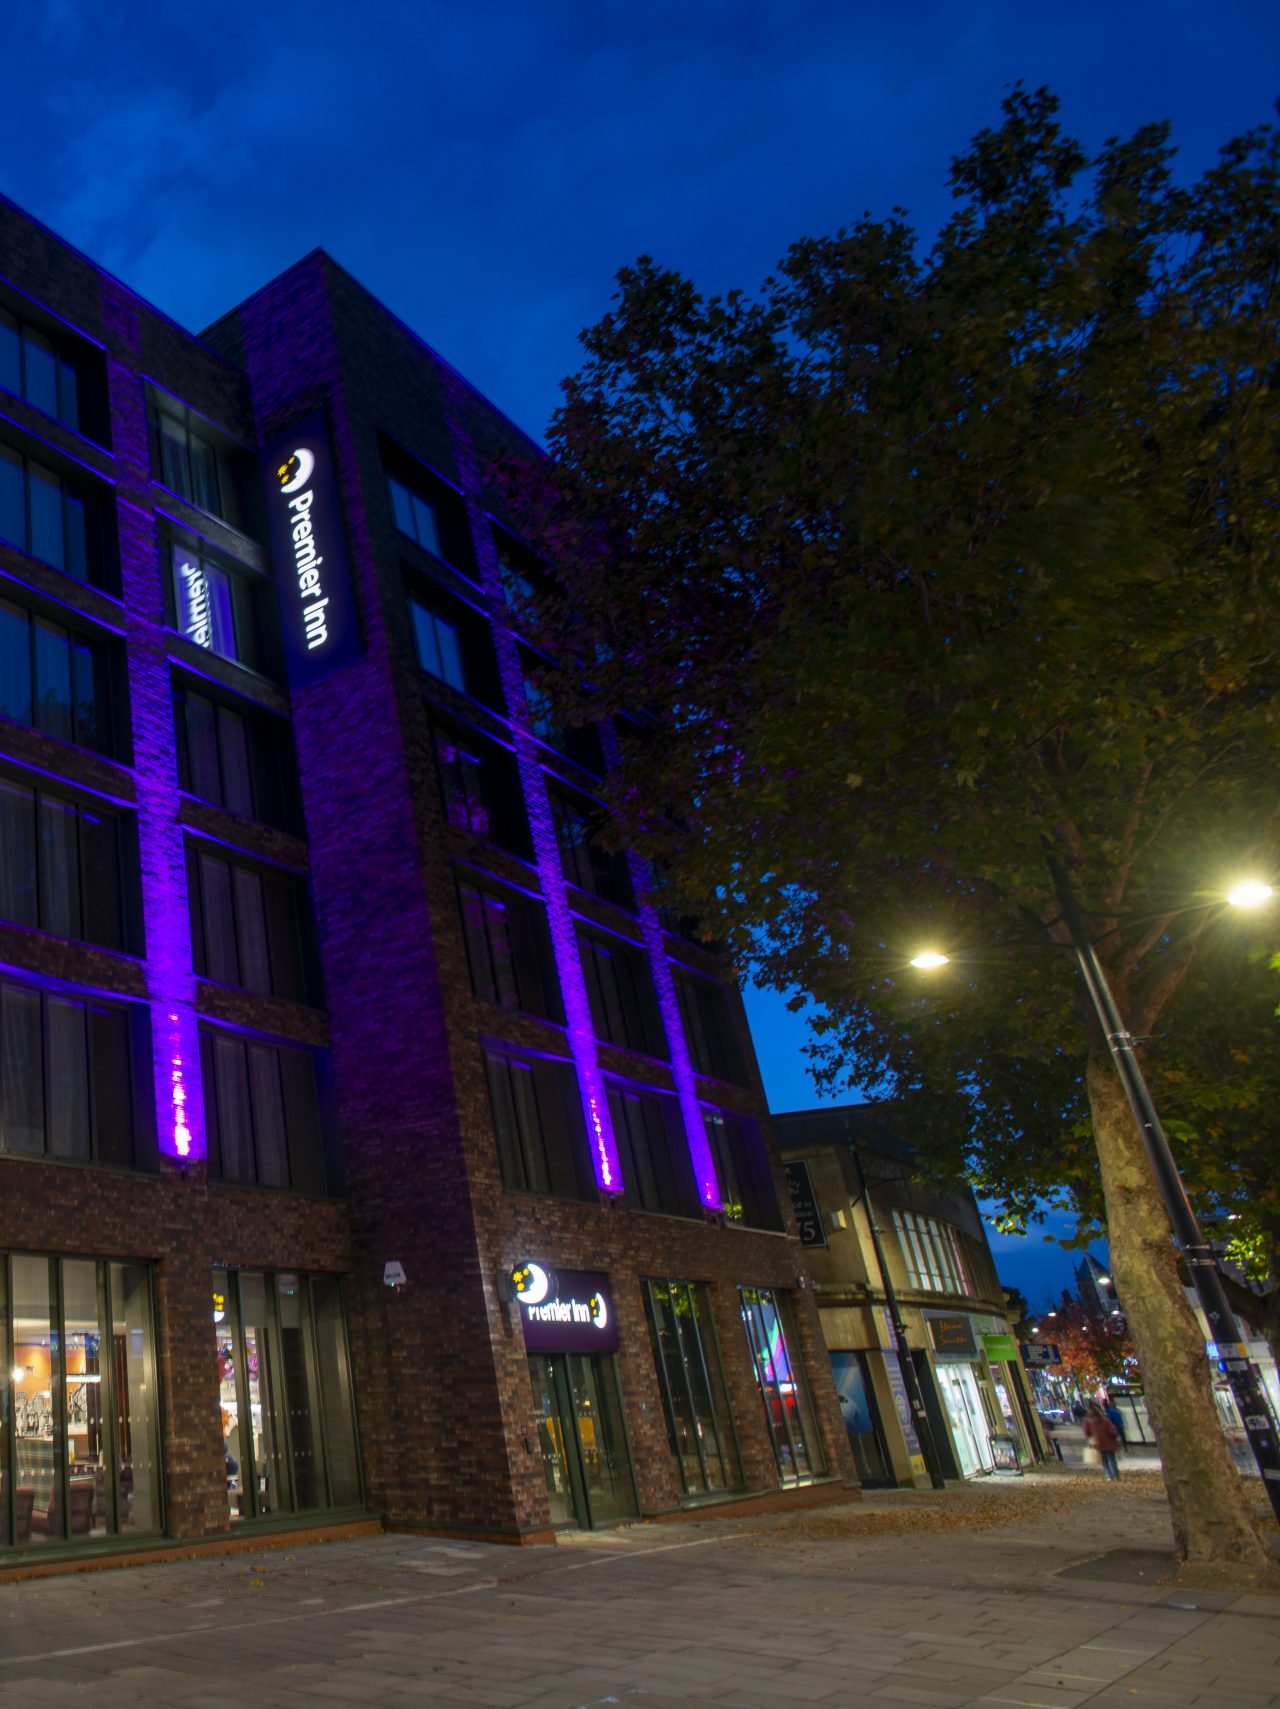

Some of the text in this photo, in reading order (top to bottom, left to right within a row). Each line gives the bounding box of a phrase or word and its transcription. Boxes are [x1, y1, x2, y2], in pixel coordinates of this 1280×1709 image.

[288, 490, 329, 650] Premier Inn
[571, 1298, 591, 1323] Inn
